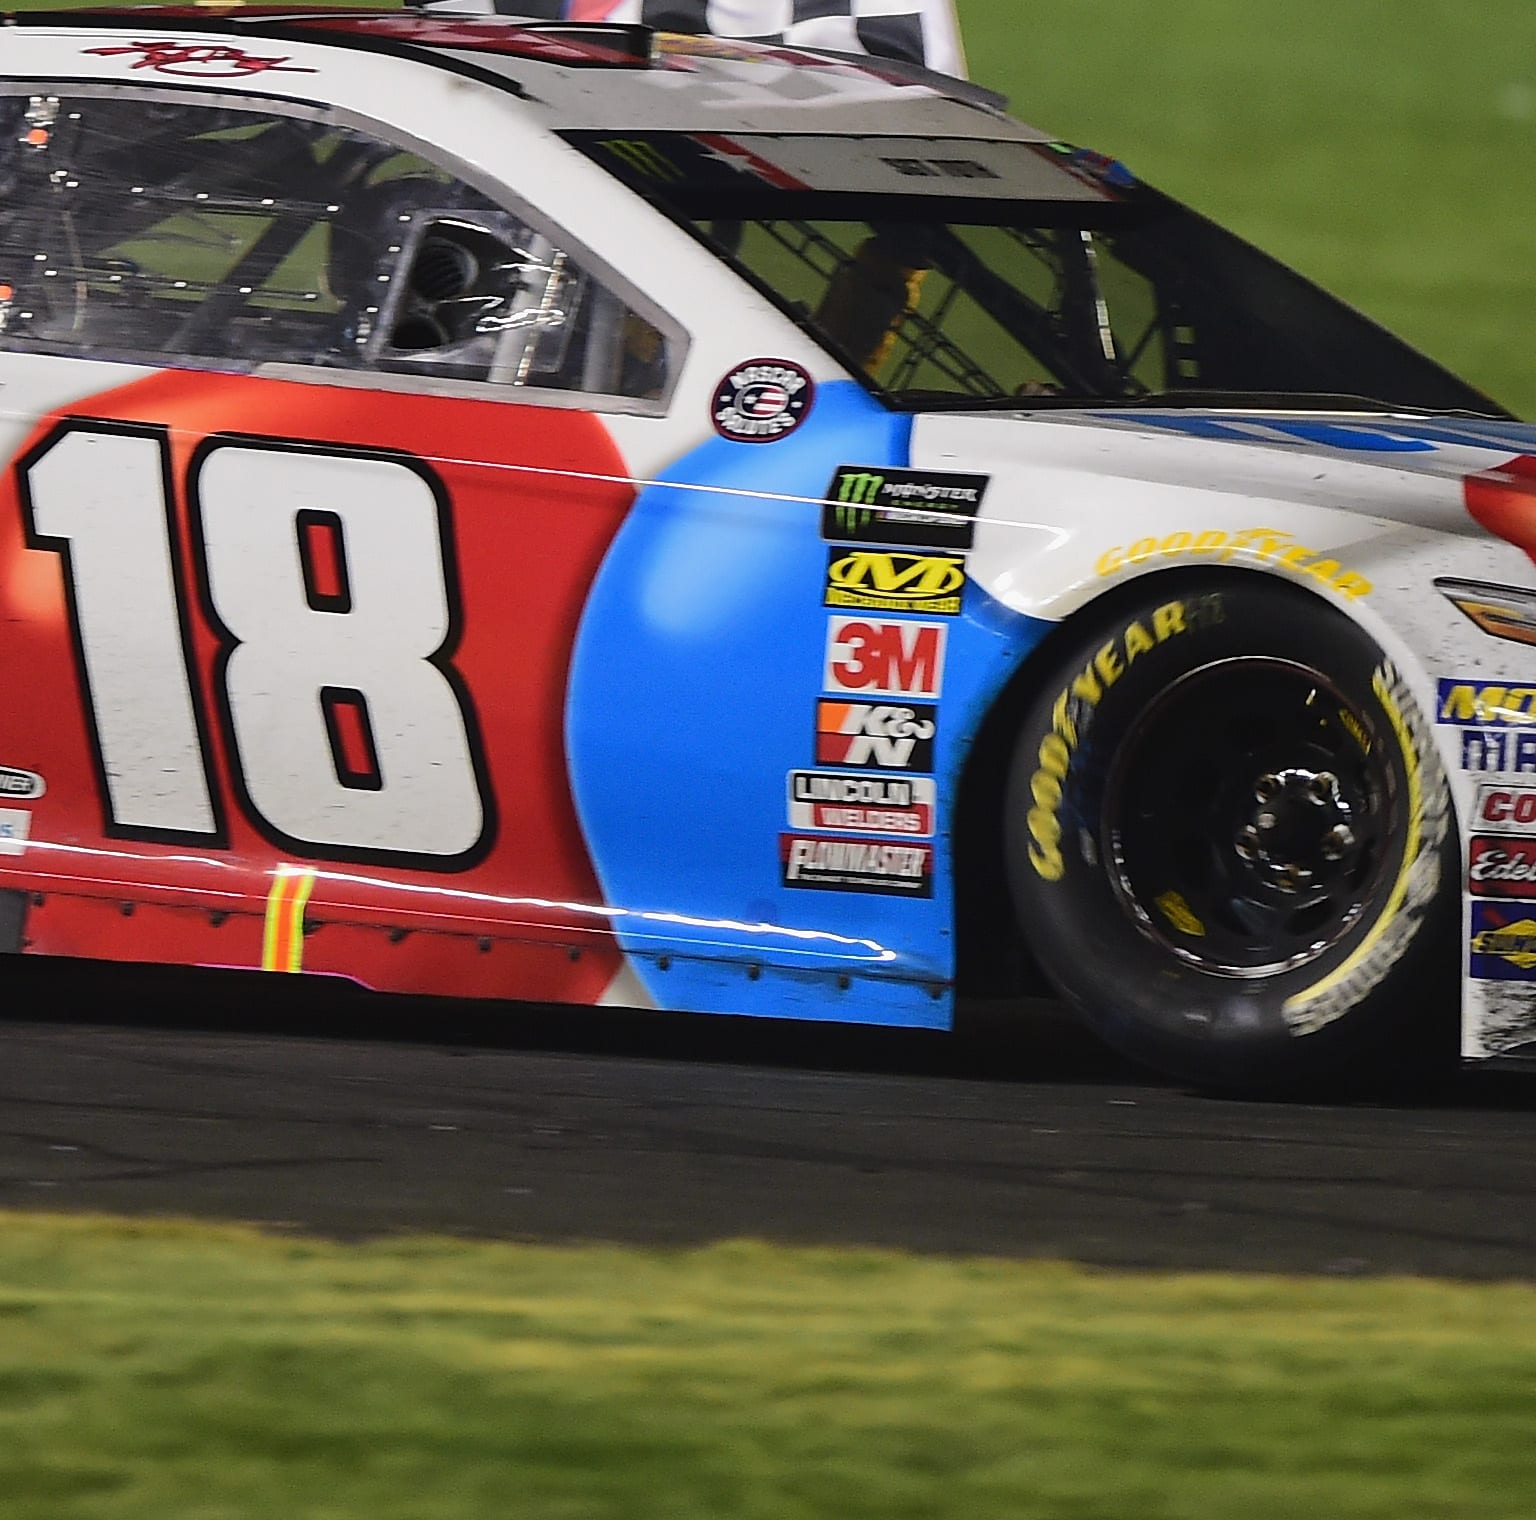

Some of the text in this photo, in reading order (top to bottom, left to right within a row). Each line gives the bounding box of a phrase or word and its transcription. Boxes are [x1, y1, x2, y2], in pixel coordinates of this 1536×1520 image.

[1095, 528, 1373, 601] GOODYEAR
[16, 415, 499, 872] 18
[832, 621, 940, 693] 3M
[838, 703, 936, 767] K&N
[1028, 600, 1185, 881] GOODYEAR
[795, 776, 912, 806] LINCOLN
